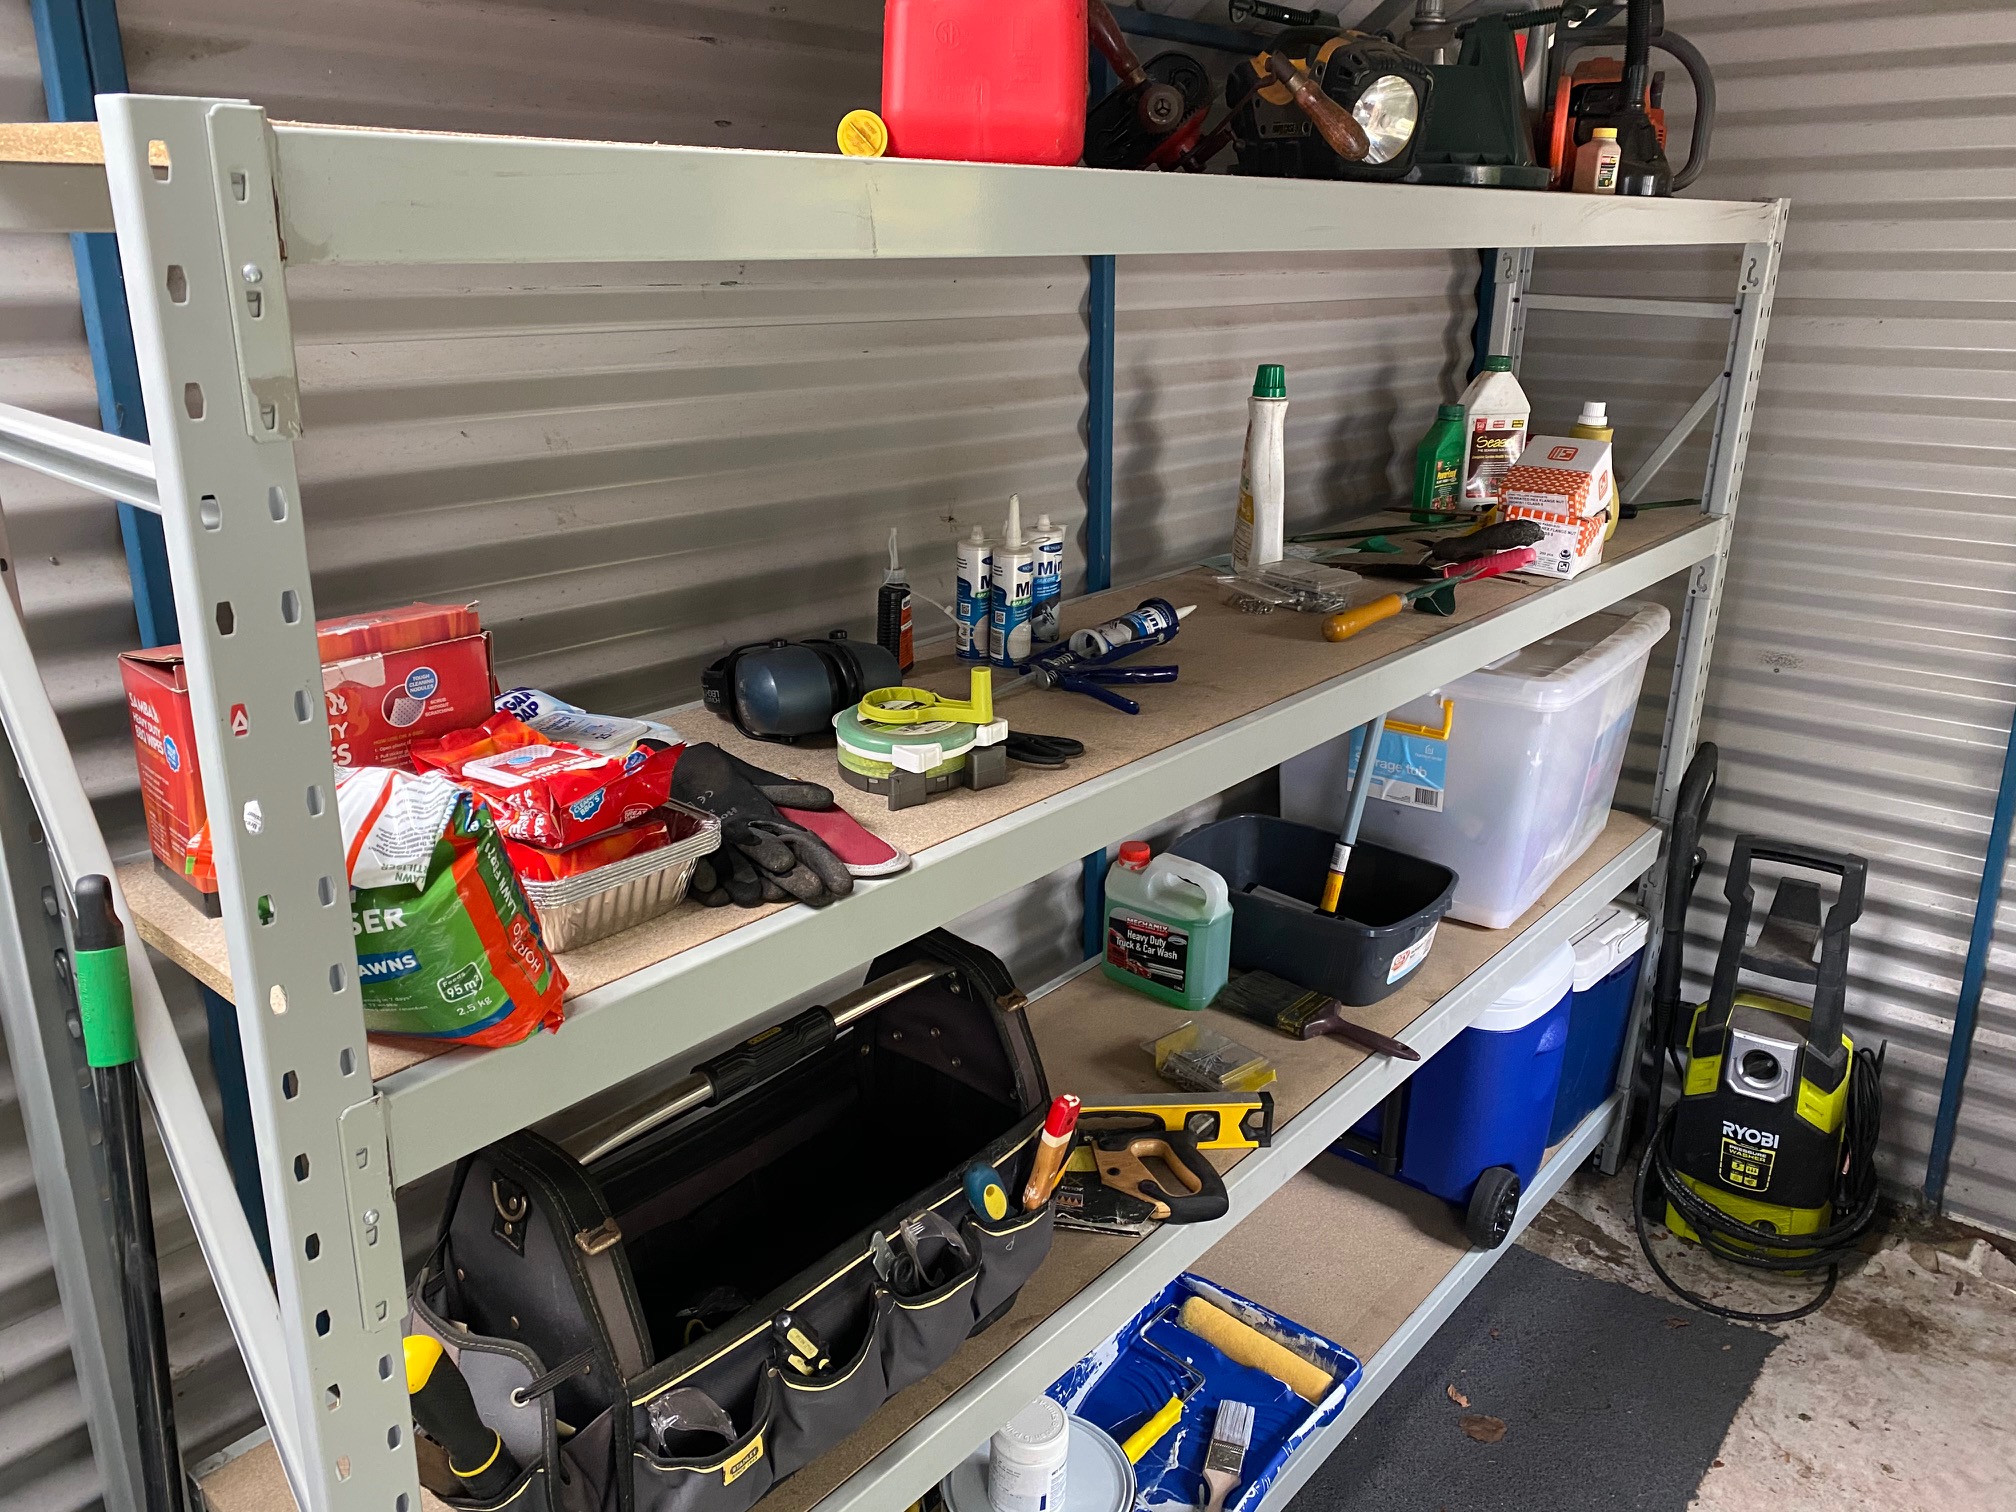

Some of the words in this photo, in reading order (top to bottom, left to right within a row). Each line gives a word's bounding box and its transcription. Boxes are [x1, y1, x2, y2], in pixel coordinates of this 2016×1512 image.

[408, 678, 435, 688] CLEANING
[412, 673, 430, 682] TOUGH
[409, 684, 434, 693] NODULES
[425, 706, 454, 717] SCRATCHING
[428, 702, 449, 711] WITHOUT
[513, 701, 539, 722] OAP
[328, 721, 348, 741] TY
[146, 732, 165, 756] WIPES
[1355, 751, 1402, 773] Srage
[381, 863, 428, 874] RTILISER
[395, 871, 426, 883] LAWN
[499, 881, 517, 915] LAWN
[1126, 917, 1168, 934] MECHANIX
[513, 922, 541, 973] HORTCO
[1127, 929, 1148, 945] Heavy
[1149, 935, 1167, 949] Duty
[1116, 936, 1135, 950] Truck
[1135, 943, 1142, 952] &
[1142, 944, 1156, 955] Car
[1157, 947, 1178, 960] Wash
[359, 955, 417, 977] AWNS
[442, 972, 466, 988] Feeds
[446, 983, 463, 998] 95
[456, 1003, 476, 1016] 2.5
[477, 995, 493, 1008] kg
[1722, 1120, 1780, 1149] RYOBI
[1729, 1144, 1767, 1159] PRESSURE
[1729, 1148, 1766, 1163] WASHER
